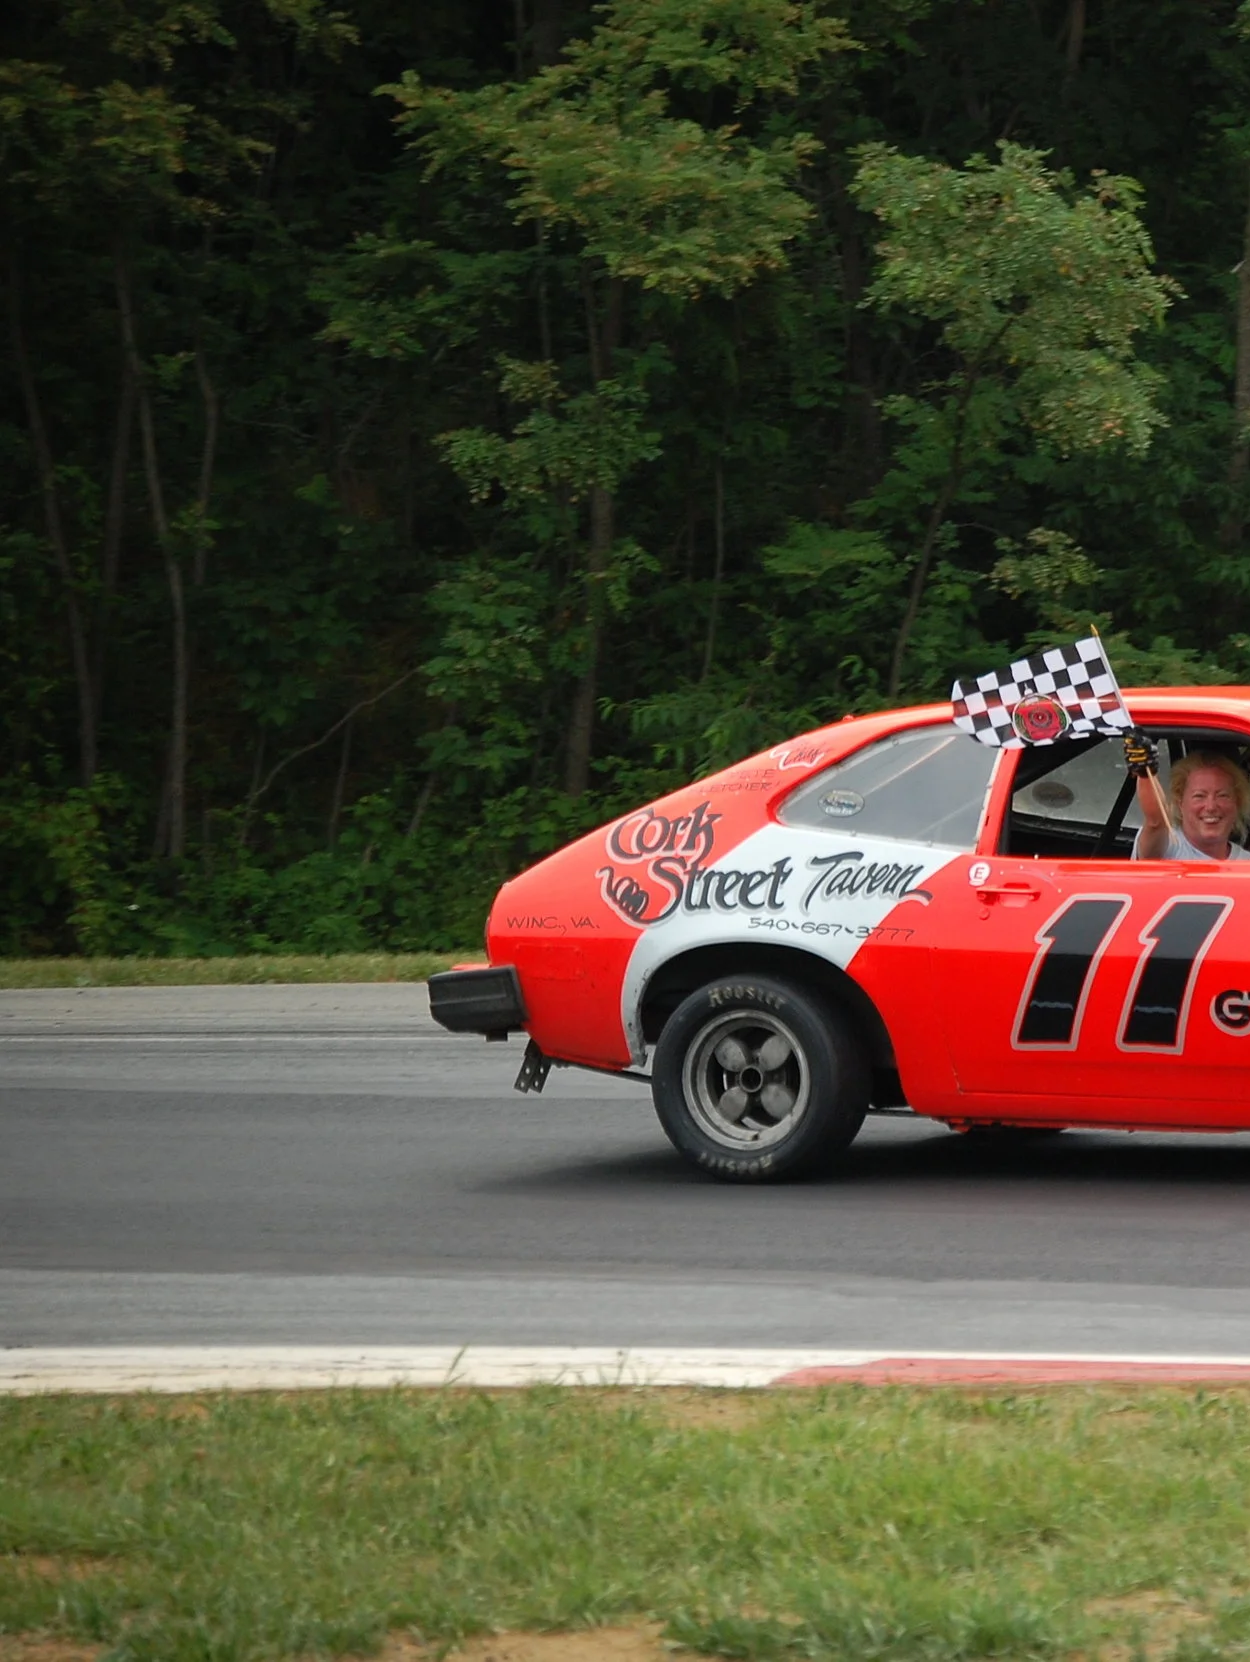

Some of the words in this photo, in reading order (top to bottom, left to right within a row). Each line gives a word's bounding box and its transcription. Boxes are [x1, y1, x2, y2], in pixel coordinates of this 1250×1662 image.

[605, 801, 722, 862] Cork
[594, 855, 793, 926] Street
[804, 851, 932, 909] Tavern
[1011, 894, 1235, 1055] 11
